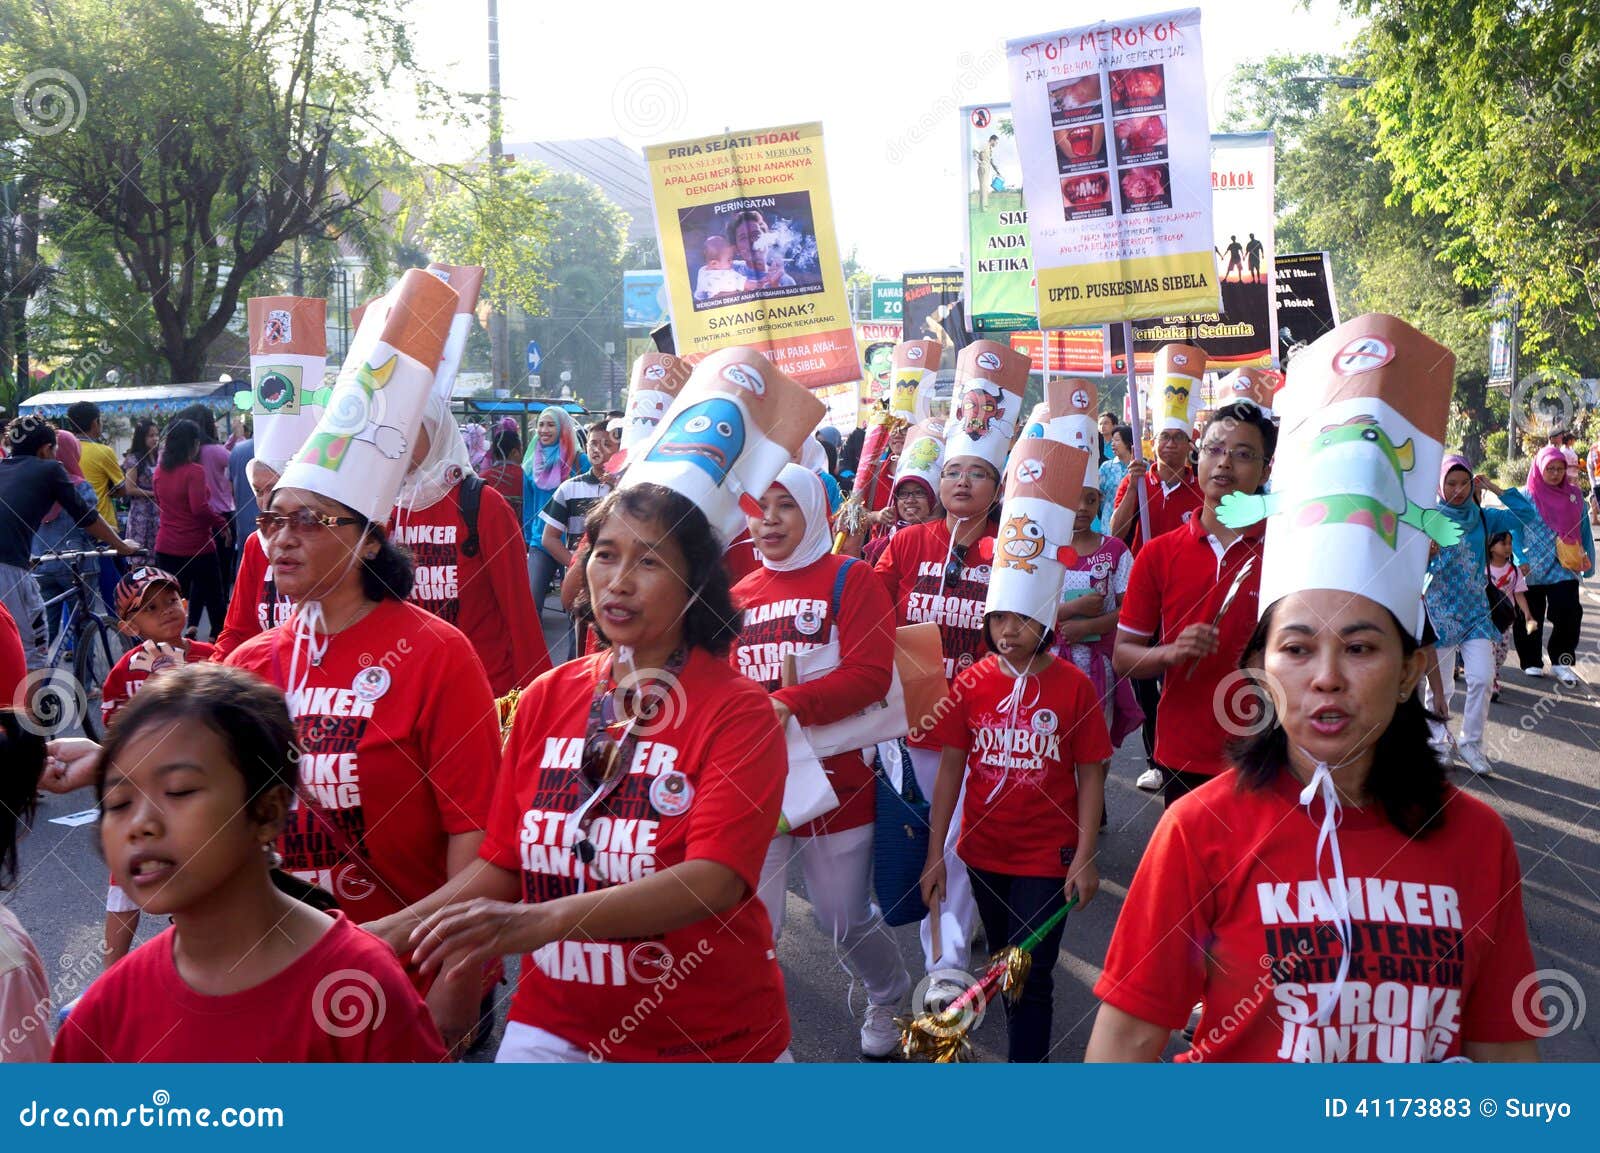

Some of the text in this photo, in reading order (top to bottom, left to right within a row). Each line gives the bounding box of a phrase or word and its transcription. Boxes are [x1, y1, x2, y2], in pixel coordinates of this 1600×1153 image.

[1021, 21, 1184, 67] STOP MEROKOK
[1025, 69, 1049, 82] ATAU
[1126, 49, 1164, 63] SEPERTI
[668, 131, 800, 159] PRIA SEJATI TIDAK
[765, 145, 813, 159] MEROKOK
[664, 157, 813, 187] APALAGI MERACUNI ANAKNYA
[686, 172, 795, 196] DENGAN ASAP ROKOK
[1212, 171, 1255, 188] Rokok
[713, 198, 776, 215] PERINGATAN
[988, 234, 1026, 249] ANDA
[977, 257, 1029, 273] KETIKA
[1048, 272, 1208, 302] UPTD. PUSKESMAS SIBELA
[1283, 298, 1315, 308] Rokok
[709, 303, 815, 330] SAYANG ANAK?
[758, 321, 793, 333] MEROKOK
[795, 315, 835, 328] SEKARANG
[1198, 322, 1255, 338] Sedunia
[787, 346, 811, 359] PARA
[797, 358, 827, 373] SIBELA
[395, 525, 457, 545] ANKER
[1087, 552, 1112, 565] MISS
[743, 598, 828, 627] KANKER
[908, 592, 986, 617] STROKE
[906, 606, 984, 630] JANTUNG
[540, 737, 678, 776] KAER
[520, 842, 656, 884] JANUNG
[1256, 876, 1463, 930] KANKER
[1265, 922, 1464, 962] IMPOTENSI
[1273, 981, 1461, 1034] STROKE
[1277, 1021, 1453, 1063] JANTUNG
